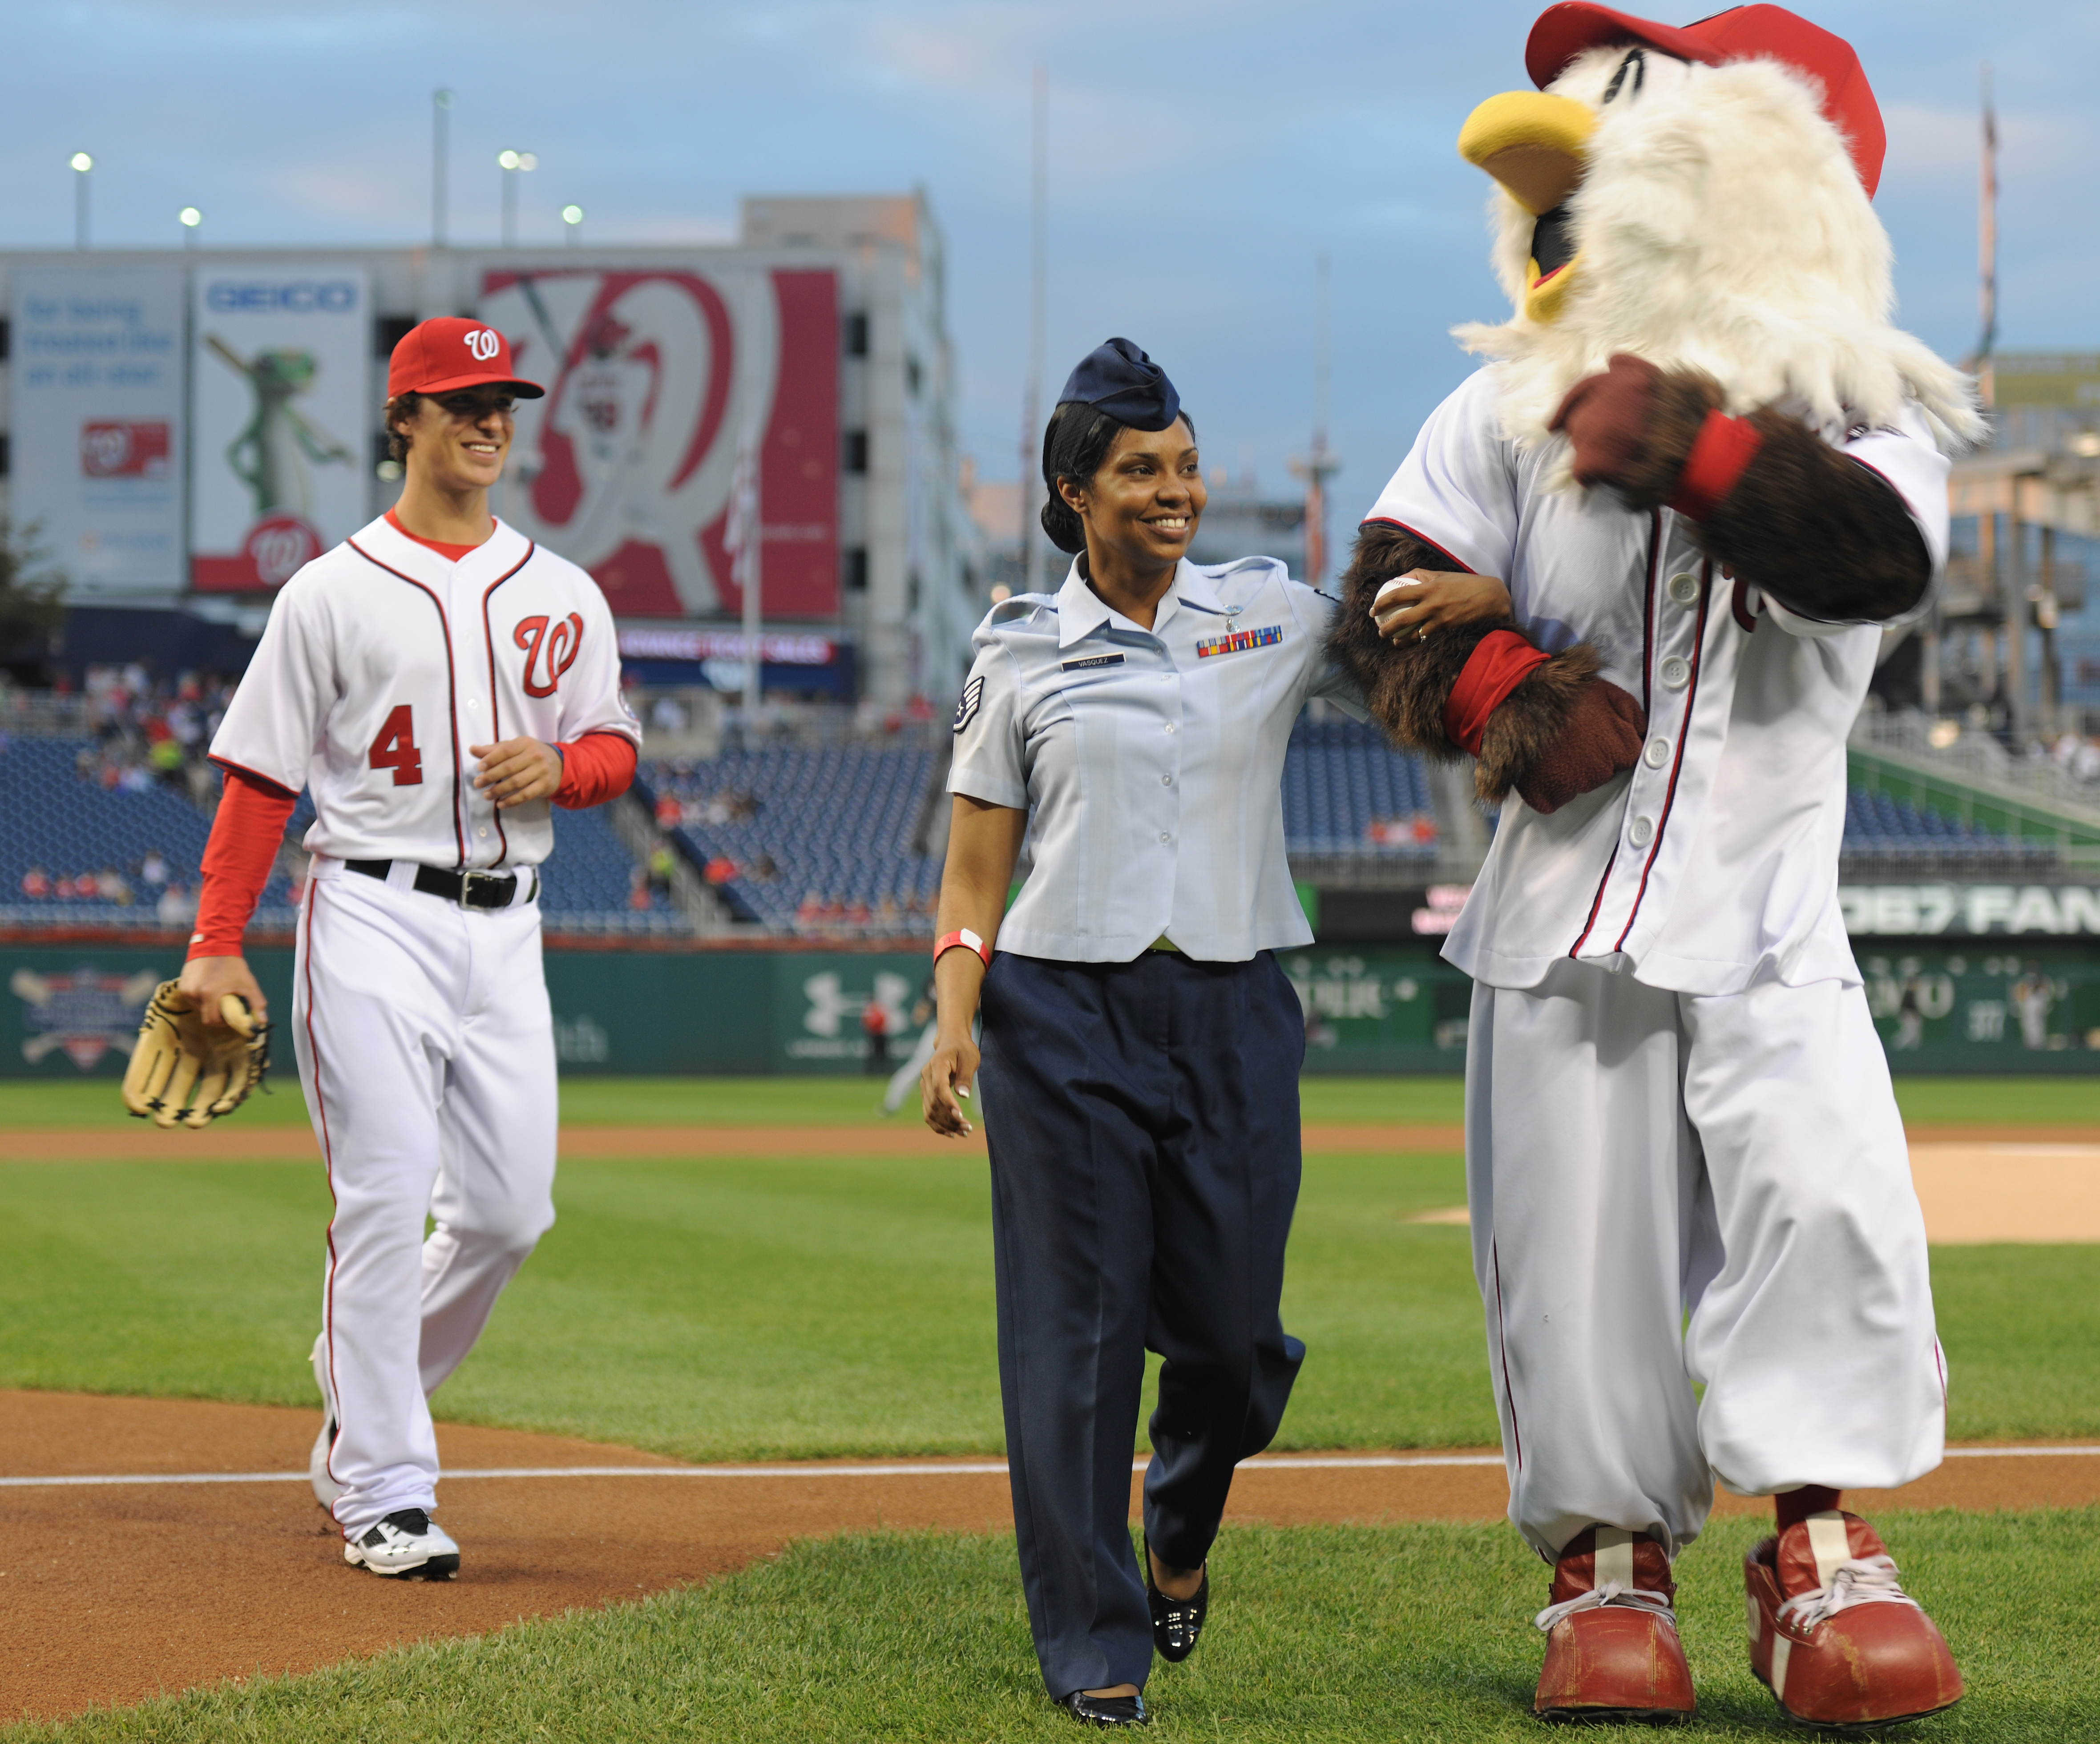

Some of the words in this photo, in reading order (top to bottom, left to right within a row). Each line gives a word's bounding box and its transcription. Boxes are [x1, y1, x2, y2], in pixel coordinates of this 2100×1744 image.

[207, 280, 357, 314] GEICO
[463, 329, 500, 361] W
[251, 528, 304, 585] W
[514, 611, 584, 698] W
[1078, 657, 1108, 667] VASQUEZ
[368, 705, 422, 786] 4
